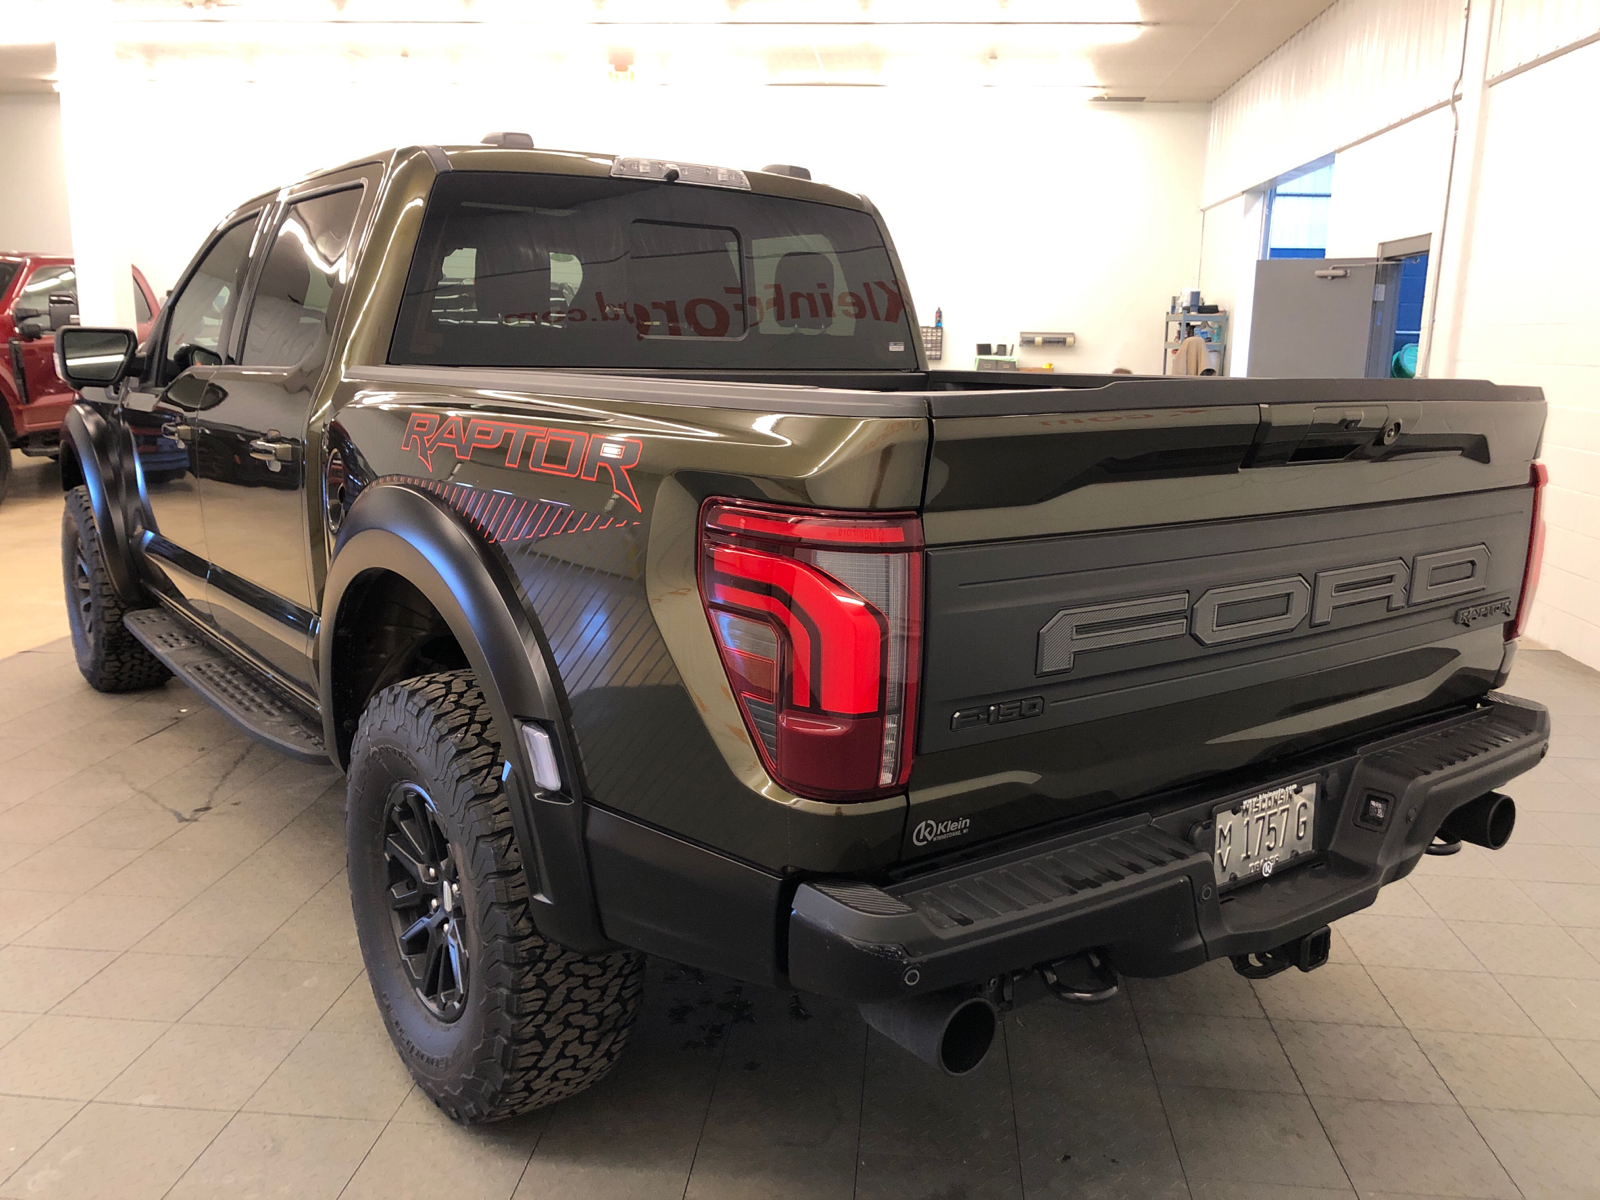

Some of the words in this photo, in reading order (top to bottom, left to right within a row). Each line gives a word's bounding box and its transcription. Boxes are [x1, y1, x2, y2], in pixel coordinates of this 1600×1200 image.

[402, 413, 642, 513] RAPTOR
[1035, 543, 1492, 678] FORD
[1455, 599, 1512, 628] RAPTOR
[937, 817, 970, 835] Klein
[1241, 804, 1290, 861] 1757
[1296, 801, 1308, 840] G
